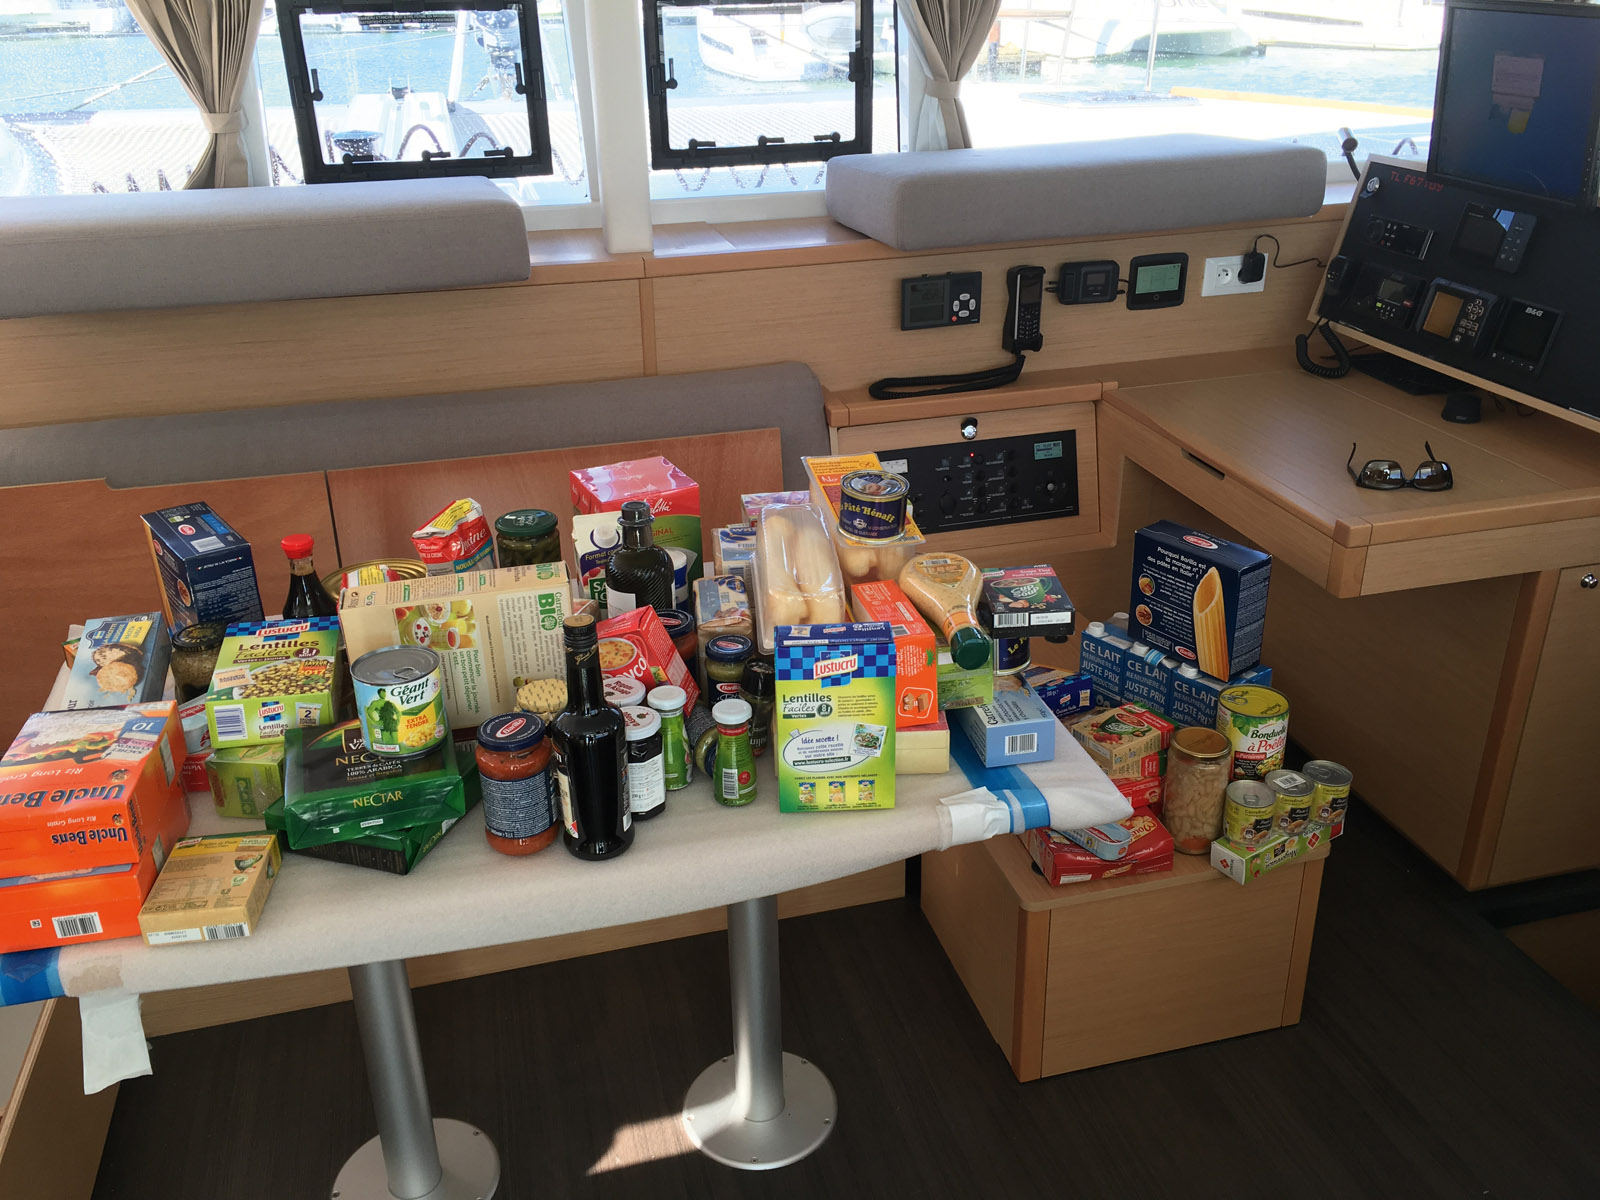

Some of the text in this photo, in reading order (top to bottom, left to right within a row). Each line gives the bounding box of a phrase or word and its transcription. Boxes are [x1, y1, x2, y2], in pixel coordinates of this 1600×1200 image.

[1525, 307, 1544, 317] B&G
[844, 502, 895, 523] Pâté Hénaff
[585, 551, 607, 560] Format
[1157, 547, 1179, 559] Pourquoi
[1180, 554, 1197, 566] Barilla
[1172, 559, 1192, 571] marque
[1011, 584, 1034, 593] Cup
[538, 593, 558, 631] BIO
[555, 592, 564, 629] Carrefour
[257, 623, 309, 637] Lustucru
[239, 640, 319, 652] Lentilles
[1082, 640, 1121, 664] CE LAIT
[236, 648, 290, 659] Faciles
[466, 651, 476, 684] commencer
[814, 655, 858, 677] Lustucru
[1127, 660, 1168, 684] CE LAIT
[1082, 661, 1120, 684] JUSTE PRIX
[390, 677, 430, 697] Géant
[400, 690, 425, 706] Vert
[782, 693, 832, 704] Lentilles
[1124, 691, 1135, 701] SON
[1125, 681, 1166, 706] JUSTE PRIX
[1174, 680, 1218, 707] CE LAIT
[258, 705, 284, 716] Lustucru
[304, 709, 312, 718] 2
[782, 703, 815, 713] Faciles
[821, 704, 827, 712] 8
[1173, 701, 1198, 719] JUSTE
[1198, 710, 1215, 727] PRIX
[406, 714, 427, 724] EXTRA
[1171, 711, 1184, 721] SON
[132, 722, 154, 732] 10
[258, 722, 289, 732] Lentilles
[405, 719, 429, 730] TENDRE
[815, 735, 835, 743] recette
[1248, 741, 1256, 752] à
[31, 767, 83, 779] Riz Long
[366, 764, 402, 775] ARABICA
[50, 784, 125, 804] Uncle
[353, 790, 403, 809] NECTAR
[47, 820, 66, 828] Grain
[68, 816, 84, 825] Long
[51, 827, 128, 845] Uncle Ben's
